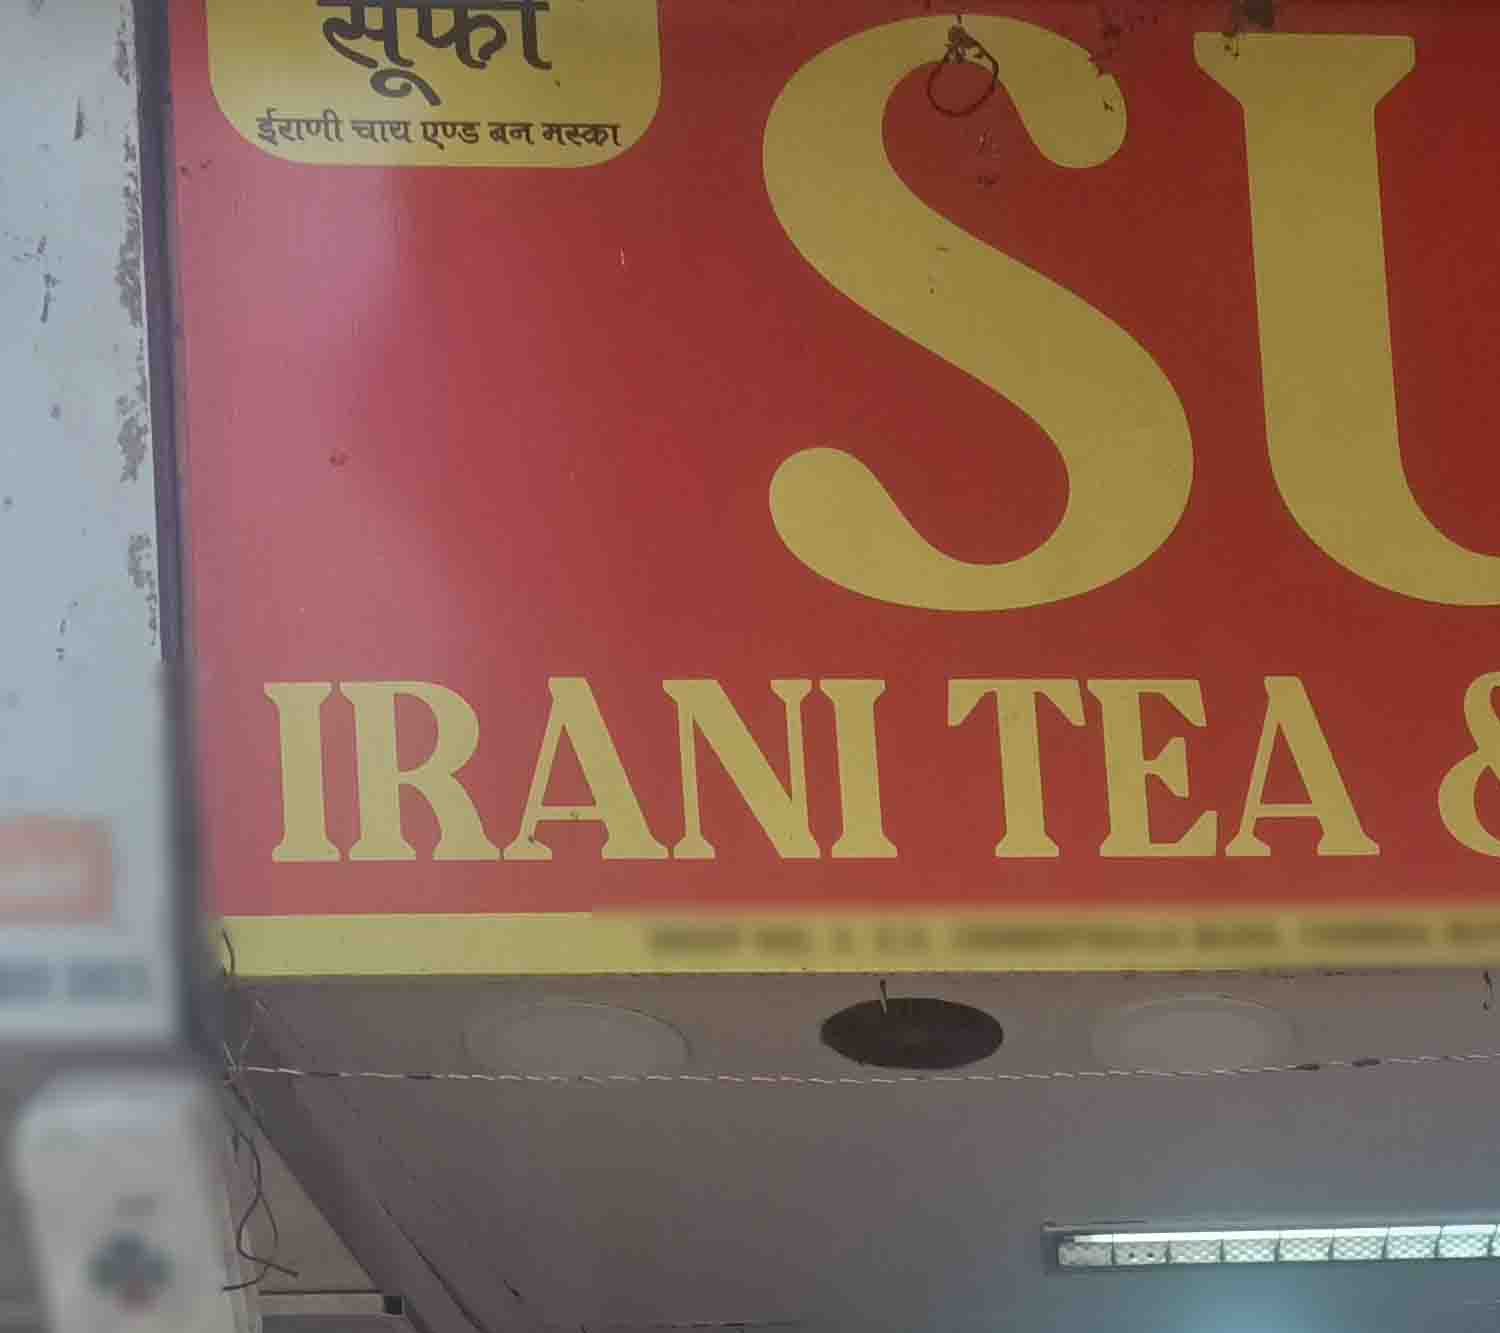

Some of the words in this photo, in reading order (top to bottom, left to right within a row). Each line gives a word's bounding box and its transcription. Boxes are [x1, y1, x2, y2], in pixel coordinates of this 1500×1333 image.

[255, 107, 345, 145] ईराणी
[350, 119, 416, 143] चाय
[420, 120, 481, 151] एण्ड
[487, 122, 535, 144] बन
[541, 122, 621, 146] मस्का
[266, 676, 897, 863] IRANI
[948, 676, 1378, 857] TEA
